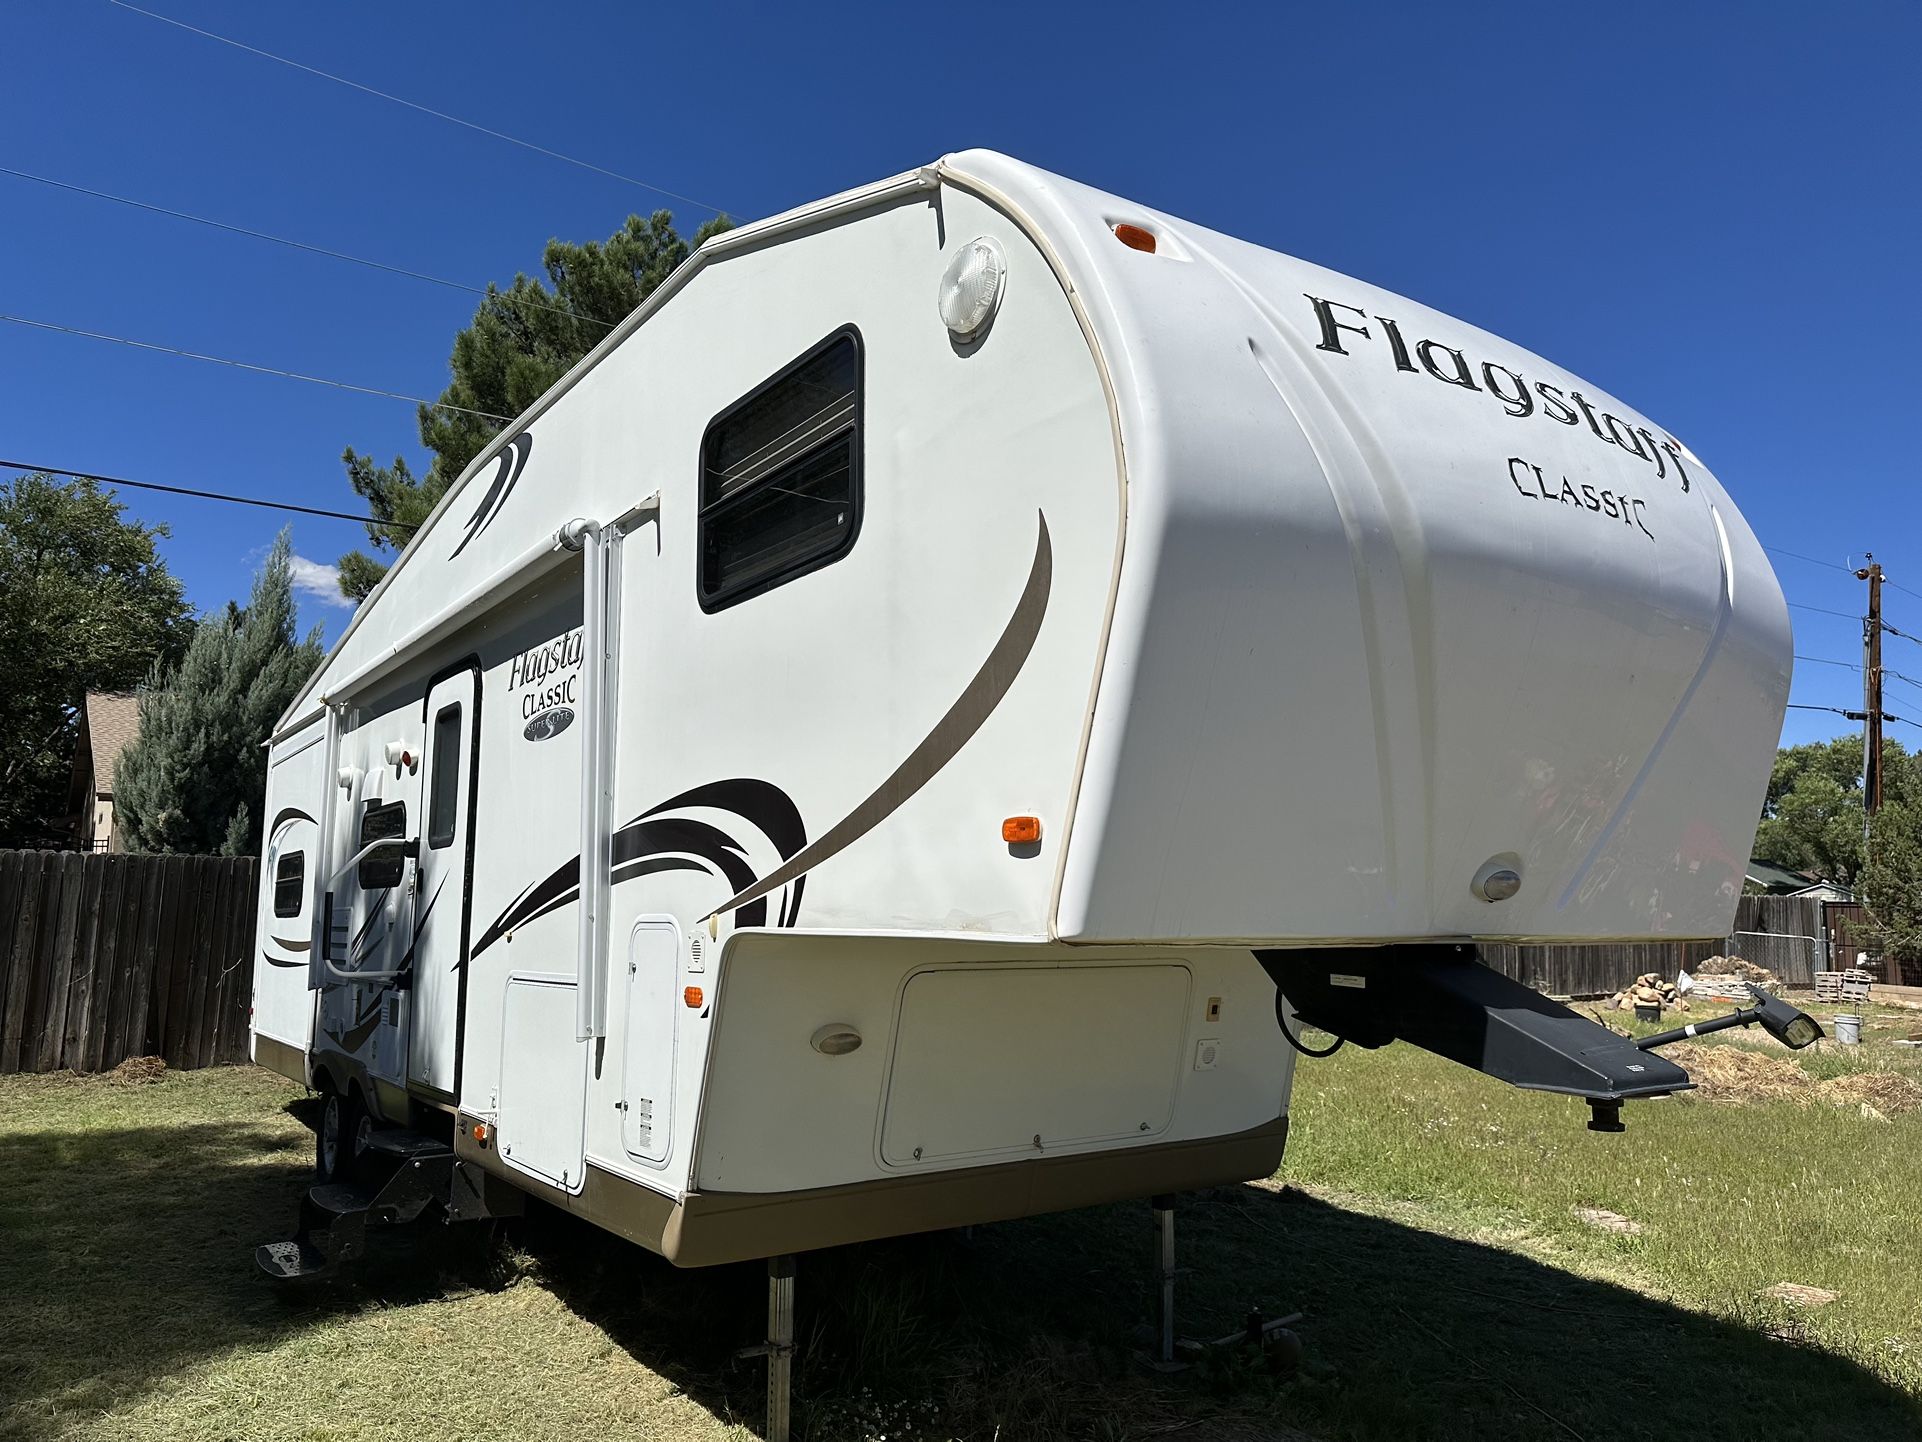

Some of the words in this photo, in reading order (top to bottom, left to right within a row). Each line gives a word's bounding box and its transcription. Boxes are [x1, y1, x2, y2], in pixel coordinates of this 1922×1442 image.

[1303, 293, 1690, 493] Flagstaff
[1507, 457, 1656, 542] CLASSIC
[508, 629, 584, 692] Flagsta
[522, 674, 577, 720] CLASSIC
